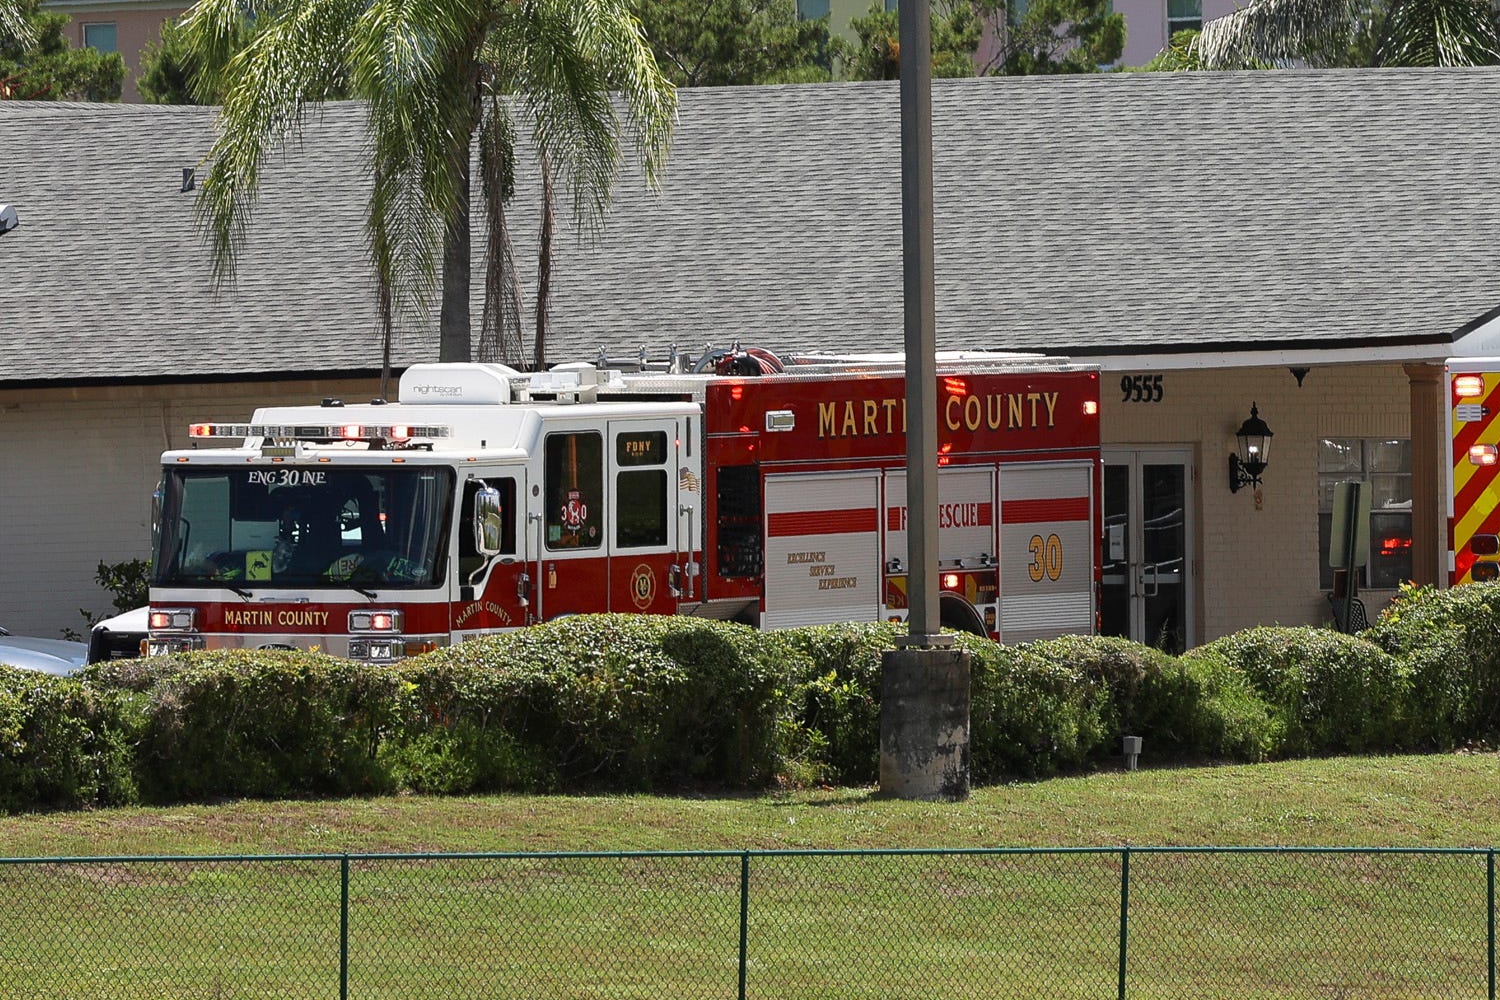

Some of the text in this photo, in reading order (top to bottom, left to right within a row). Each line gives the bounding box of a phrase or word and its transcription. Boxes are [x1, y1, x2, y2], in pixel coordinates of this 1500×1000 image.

[413, 384, 462, 395] nightscan
[1121, 375, 1163, 402] 9555
[818, 392, 1059, 439] MARTI COUNTY
[248, 471, 276, 485] ENG
[277, 469, 300, 486] 30
[939, 503, 977, 528] ESCUE
[1028, 534, 1062, 582] 30
[225, 611, 329, 625] MARTIN COUNTY
[456, 601, 512, 628] MARTIN COUNTY
